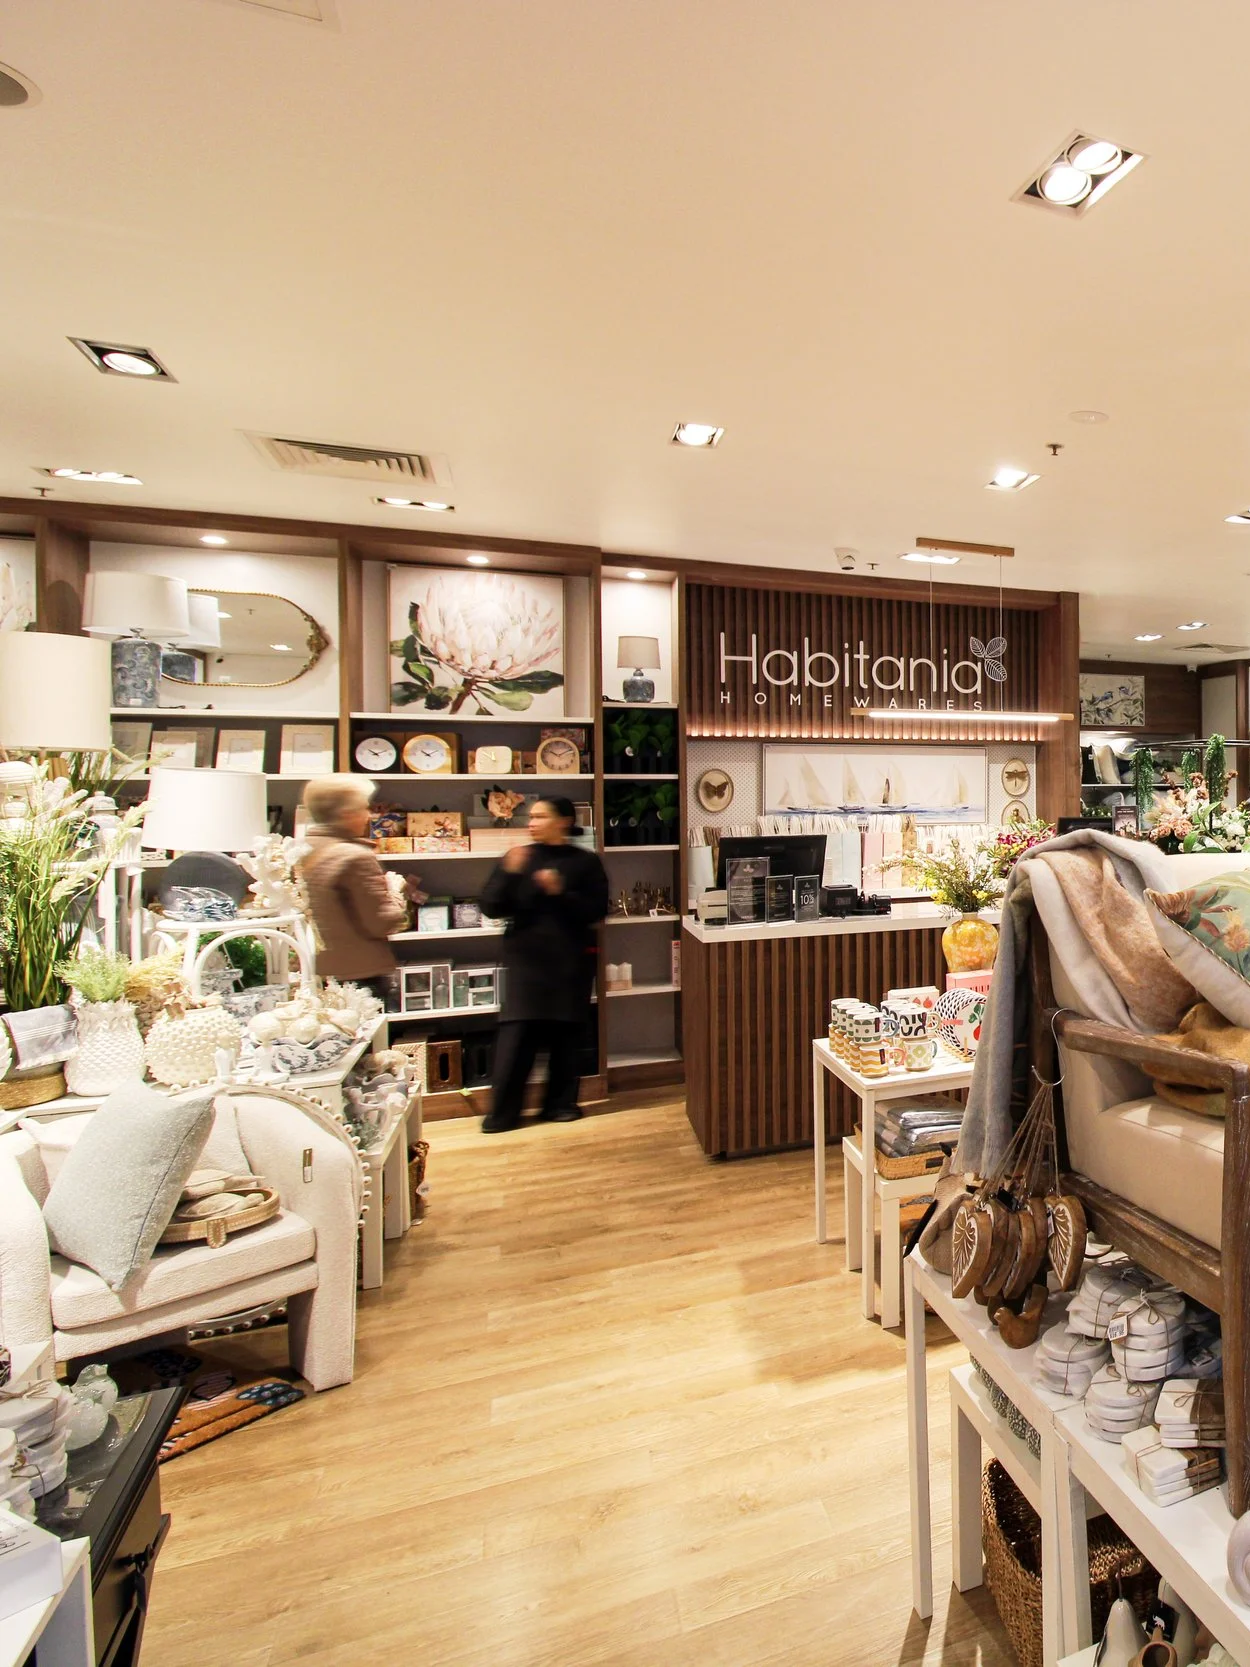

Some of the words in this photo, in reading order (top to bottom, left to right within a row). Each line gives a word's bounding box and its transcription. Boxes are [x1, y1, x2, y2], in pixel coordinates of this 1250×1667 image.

[720, 632, 982, 695] Habitania
[720, 691, 983, 711] HOMEWARES
[800, 894, 815, 905] 10%
